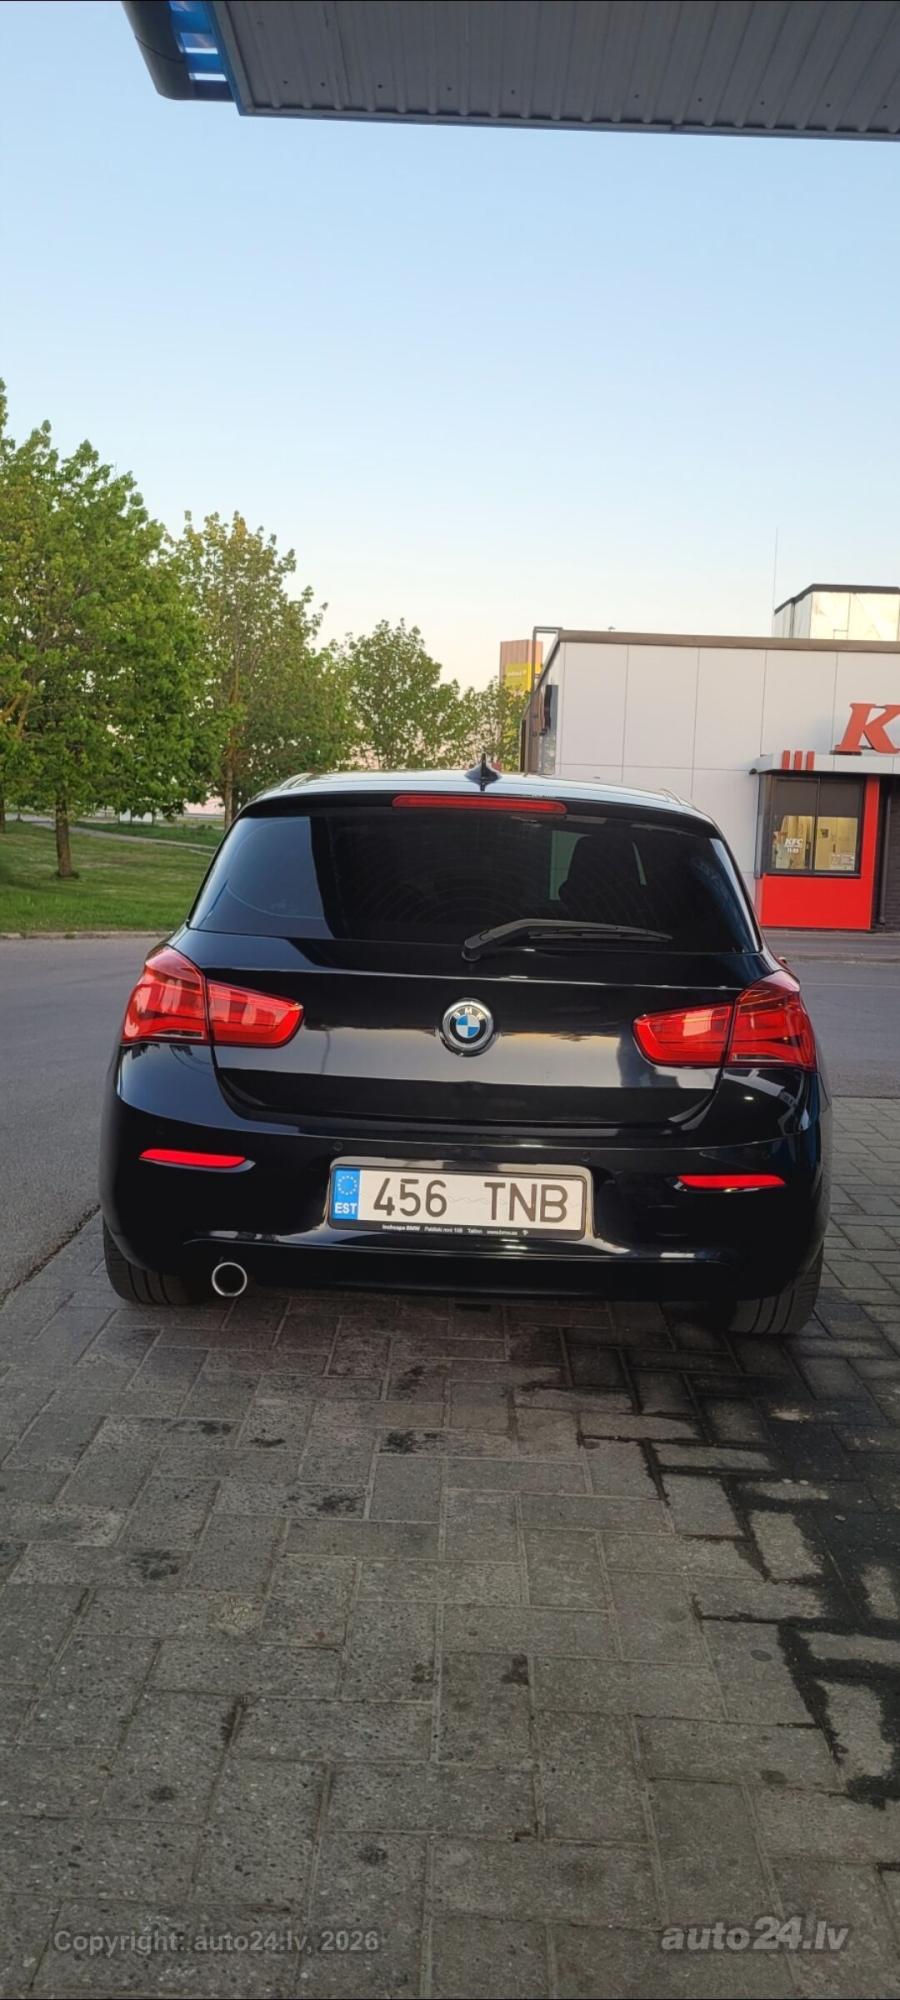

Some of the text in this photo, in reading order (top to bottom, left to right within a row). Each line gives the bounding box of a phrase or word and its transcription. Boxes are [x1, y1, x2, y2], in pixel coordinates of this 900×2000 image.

[834, 703, 900, 754] K
[453, 1007, 486, 1020] BMW
[334, 1203, 357, 1214] EST
[373, 1177, 568, 1223] 456 TNB
